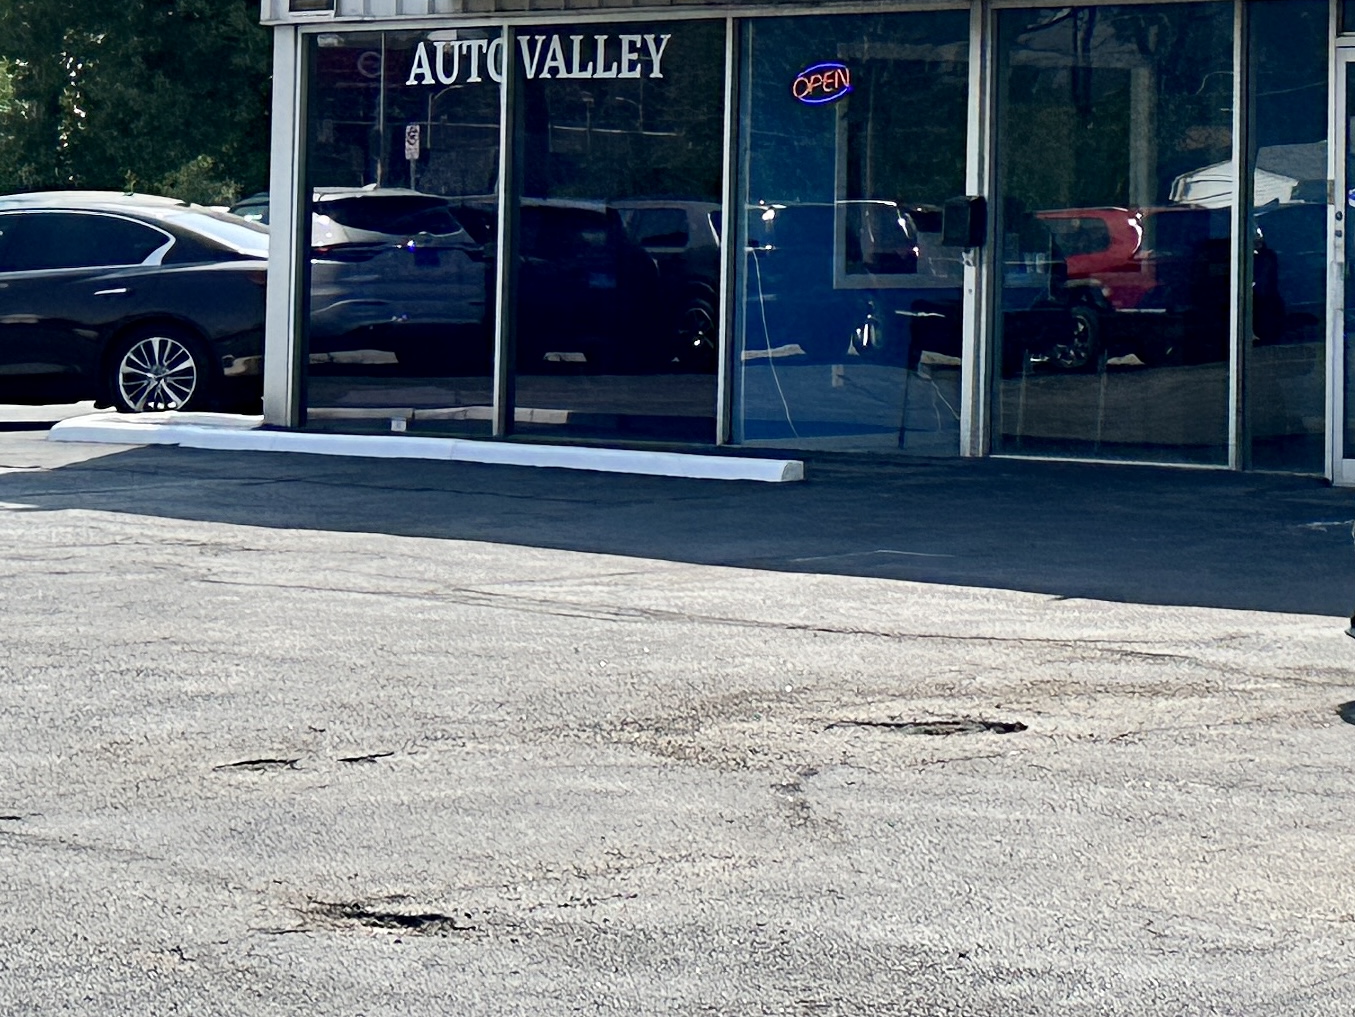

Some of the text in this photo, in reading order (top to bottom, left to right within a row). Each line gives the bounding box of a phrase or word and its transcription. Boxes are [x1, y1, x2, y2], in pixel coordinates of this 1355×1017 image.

[406, 33, 672, 86] AUTO VALLEY
[792, 67, 850, 98] OPEN
